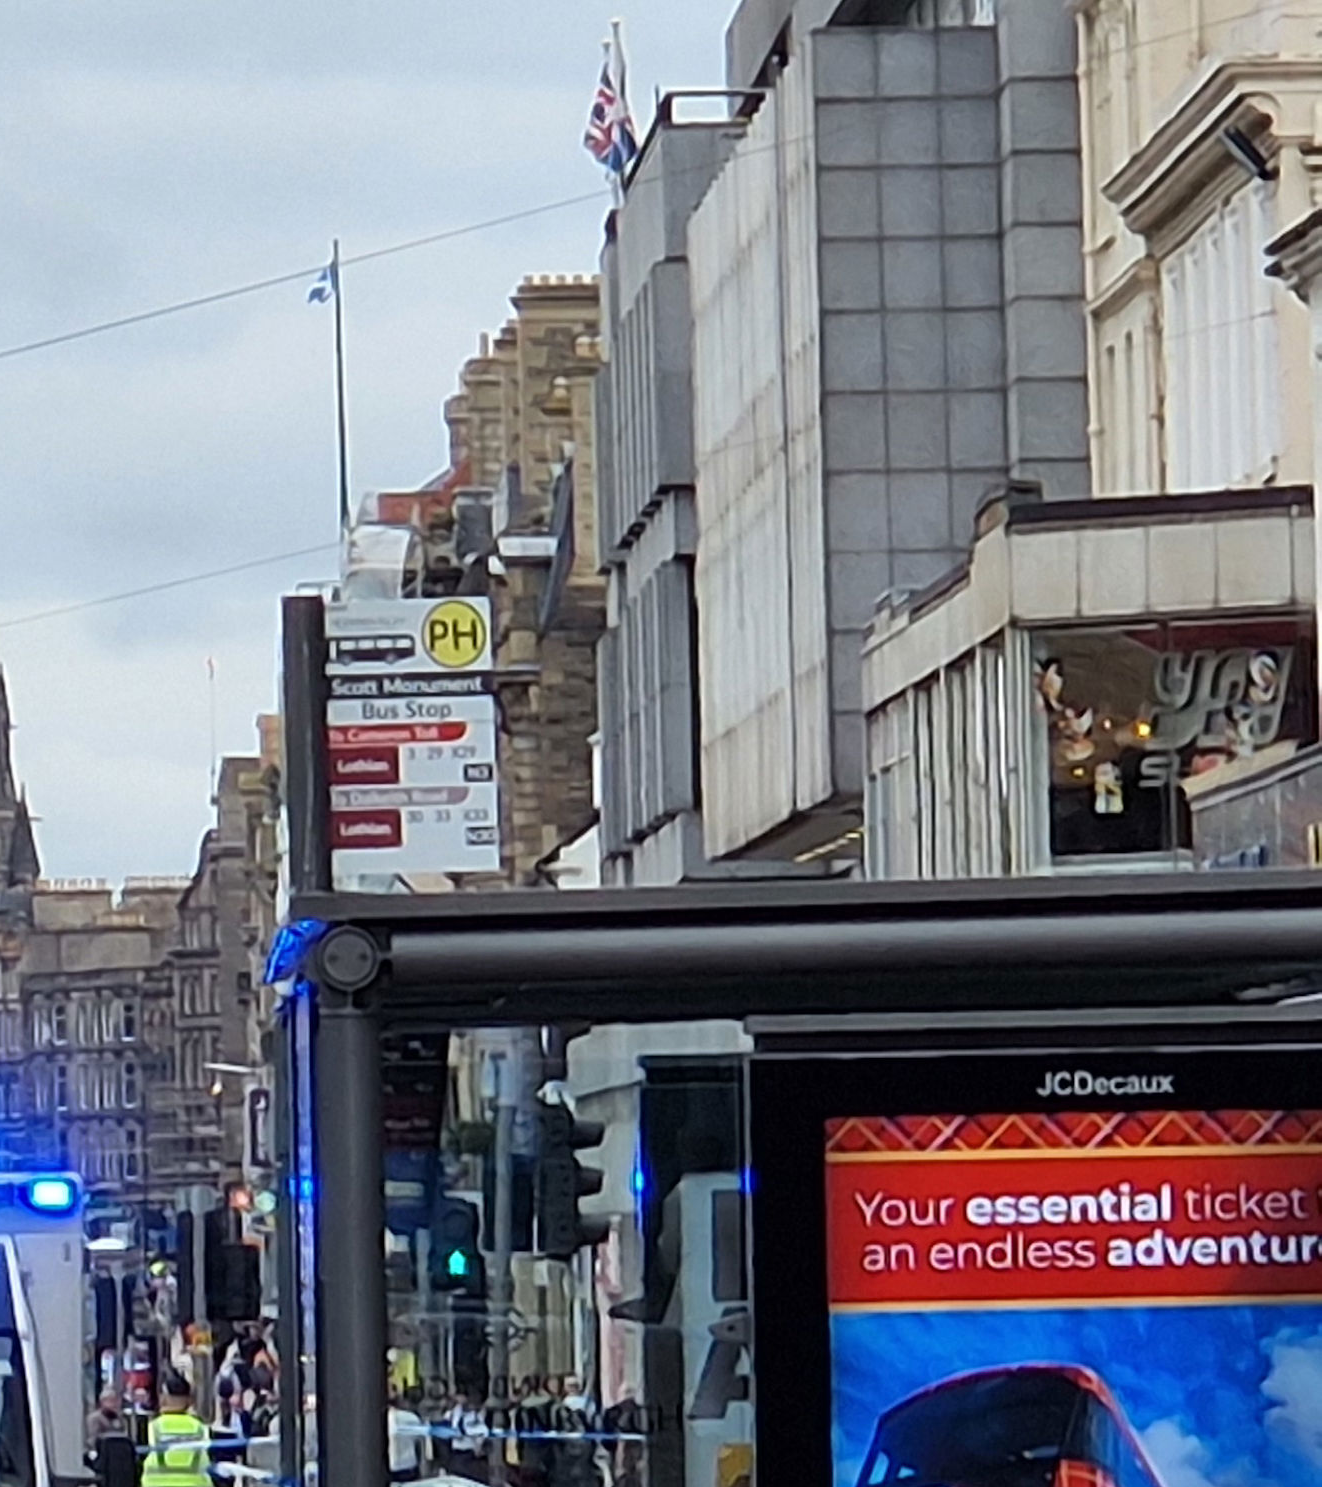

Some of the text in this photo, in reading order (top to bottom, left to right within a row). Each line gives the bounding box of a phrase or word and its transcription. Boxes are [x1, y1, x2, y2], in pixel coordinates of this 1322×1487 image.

[429, 618, 478, 652] PH
[332, 676, 483, 696] Scott Monument
[362, 700, 452, 720] Bus Stop
[1036, 1070, 1175, 1097] JCDecaux
[855, 1182, 1310, 1228] Your essential ticket
[862, 1241, 916, 1272] an
[929, 1231, 1098, 1270] endless
